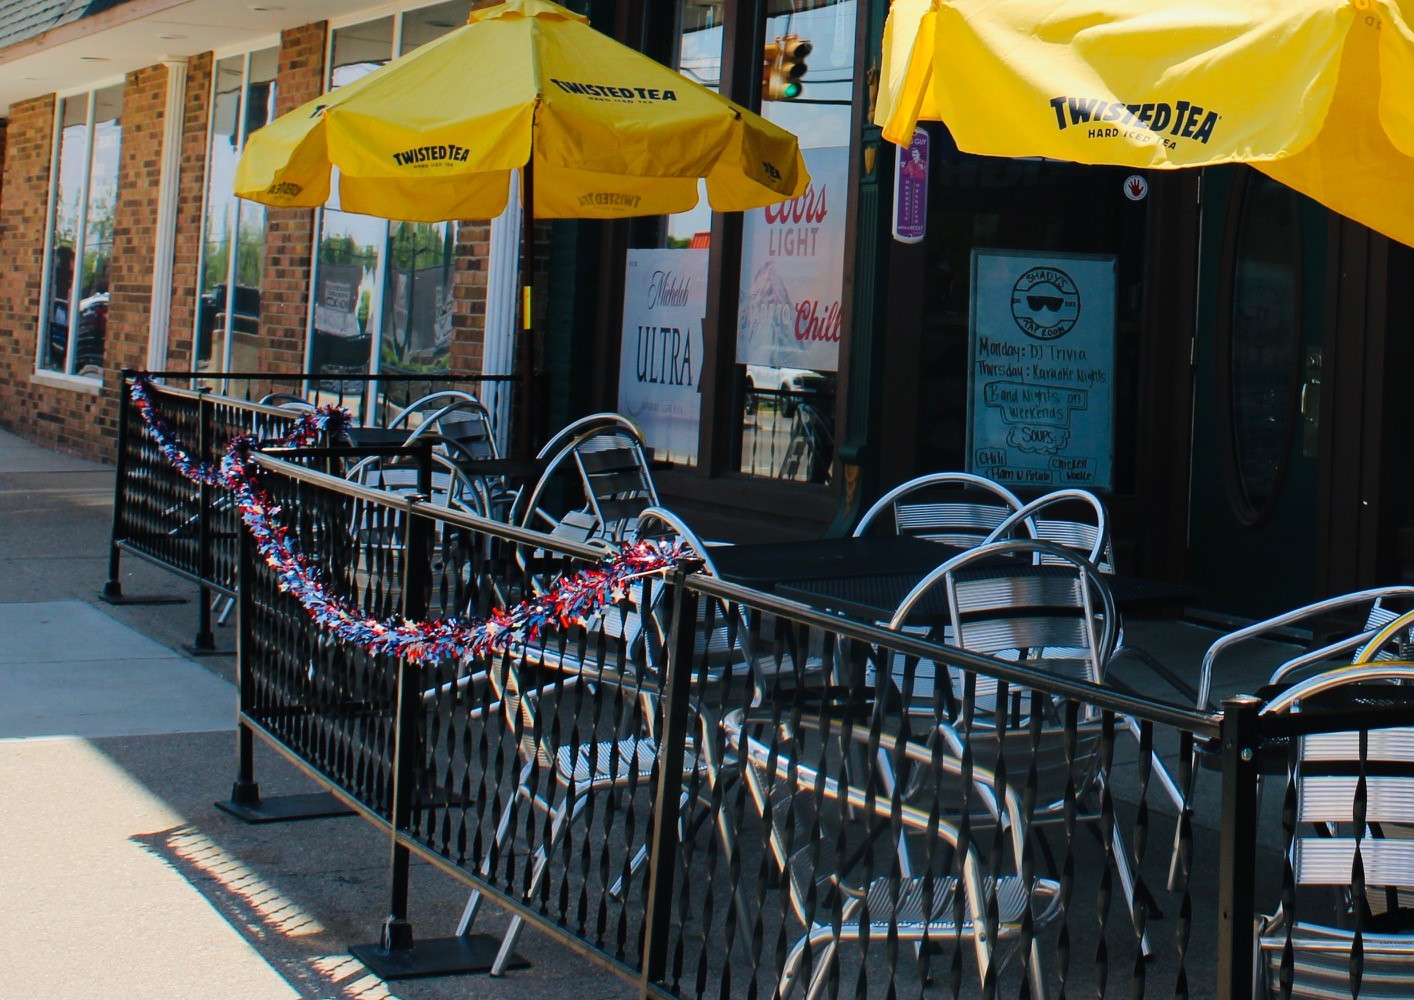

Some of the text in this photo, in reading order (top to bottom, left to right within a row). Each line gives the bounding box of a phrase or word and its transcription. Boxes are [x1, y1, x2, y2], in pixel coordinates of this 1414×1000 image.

[551, 78, 678, 102] TWISTED TEA
[1050, 96, 1218, 144] TWISTED TEA
[1088, 128, 1177, 150] HARD ICED TEA
[393, 144, 470, 166] TWISTED TEA
[769, 227, 820, 256] LIGHT
[649, 270, 692, 311] Michelob
[795, 300, 842, 342] Chill
[1023, 319, 1065, 337] TAP ROOM
[636, 325, 693, 387] ULTRA
[979, 336, 1087, 362] Monday: DJ Trivia
[1077, 367, 1106, 388] Nights
[989, 384, 1081, 407] Band Nights on
